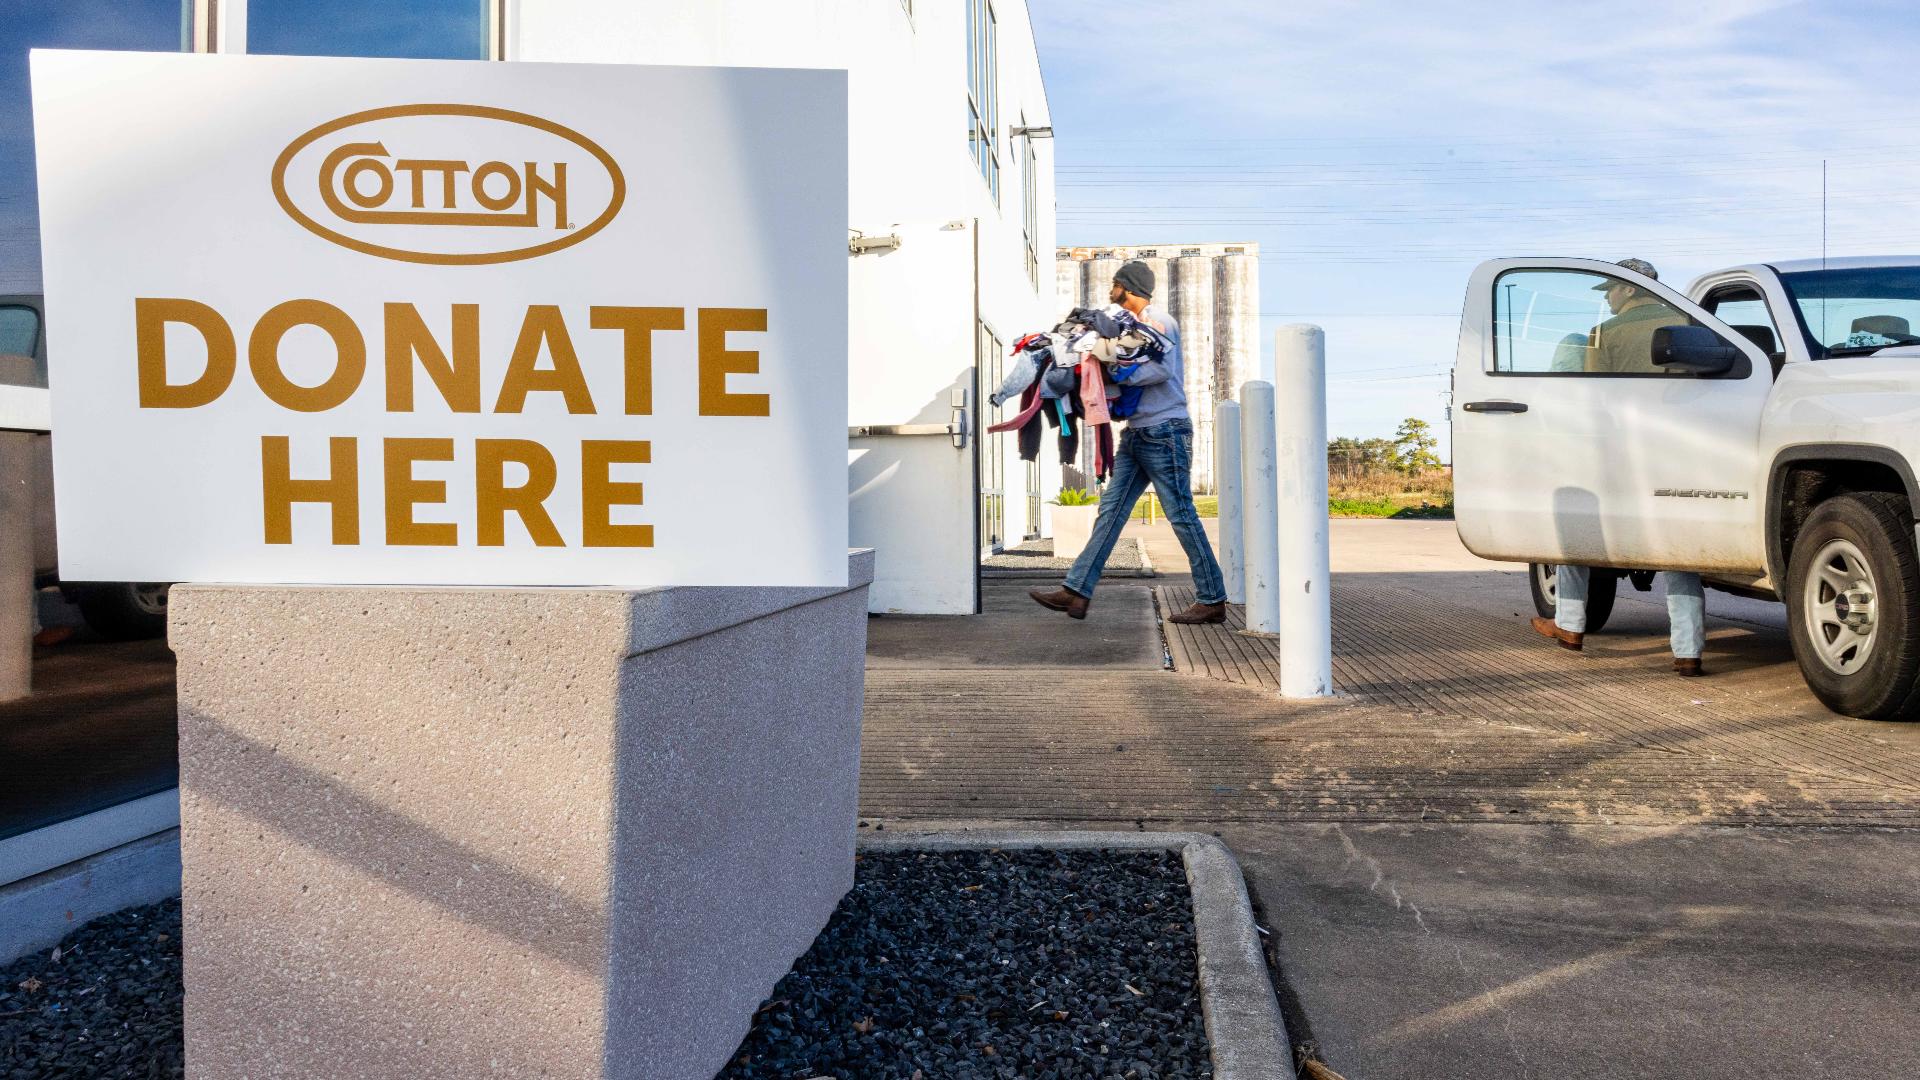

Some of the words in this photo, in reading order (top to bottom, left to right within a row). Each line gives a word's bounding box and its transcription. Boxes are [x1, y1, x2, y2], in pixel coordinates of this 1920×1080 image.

[319, 141, 568, 230] COTTON
[136, 297, 770, 417] DONATE
[262, 435, 654, 548] HERE
[1653, 488, 1748, 500] SIERRA
